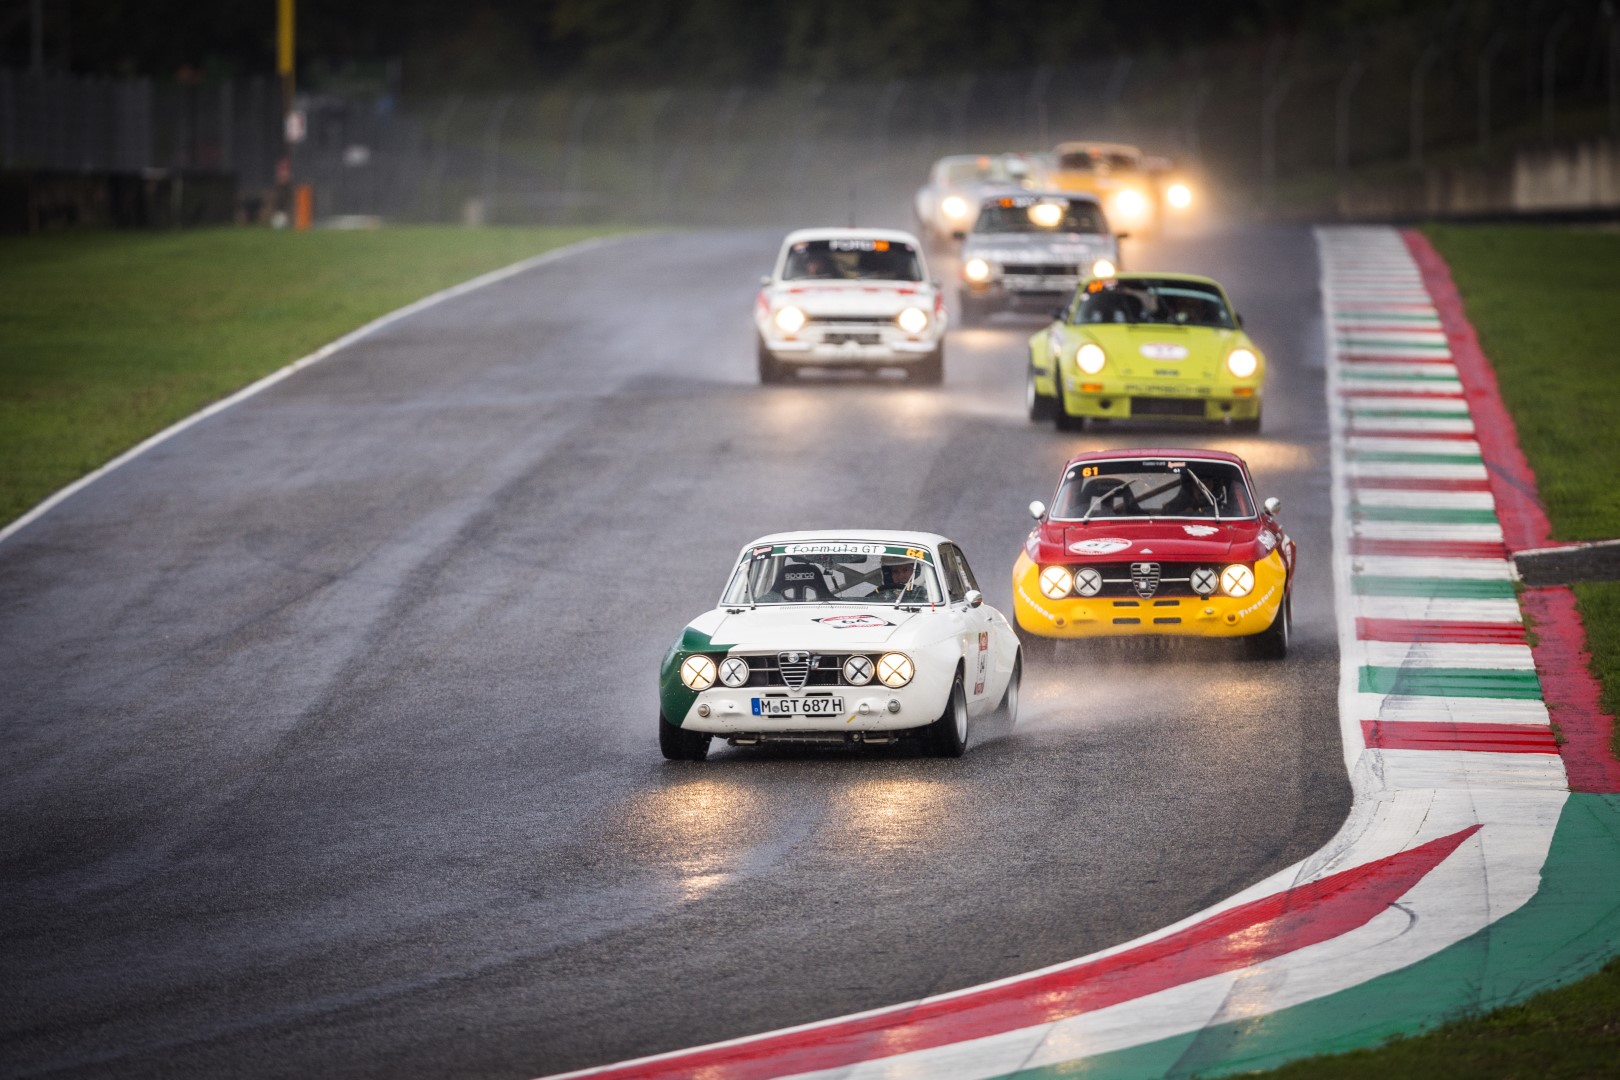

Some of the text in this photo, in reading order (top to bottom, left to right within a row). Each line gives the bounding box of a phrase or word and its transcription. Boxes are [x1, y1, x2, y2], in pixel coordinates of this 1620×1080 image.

[1082, 466, 1099, 478] 61
[792, 545, 881, 554] formula GT
[905, 547, 925, 560] 64
[785, 572, 815, 581] sparco
